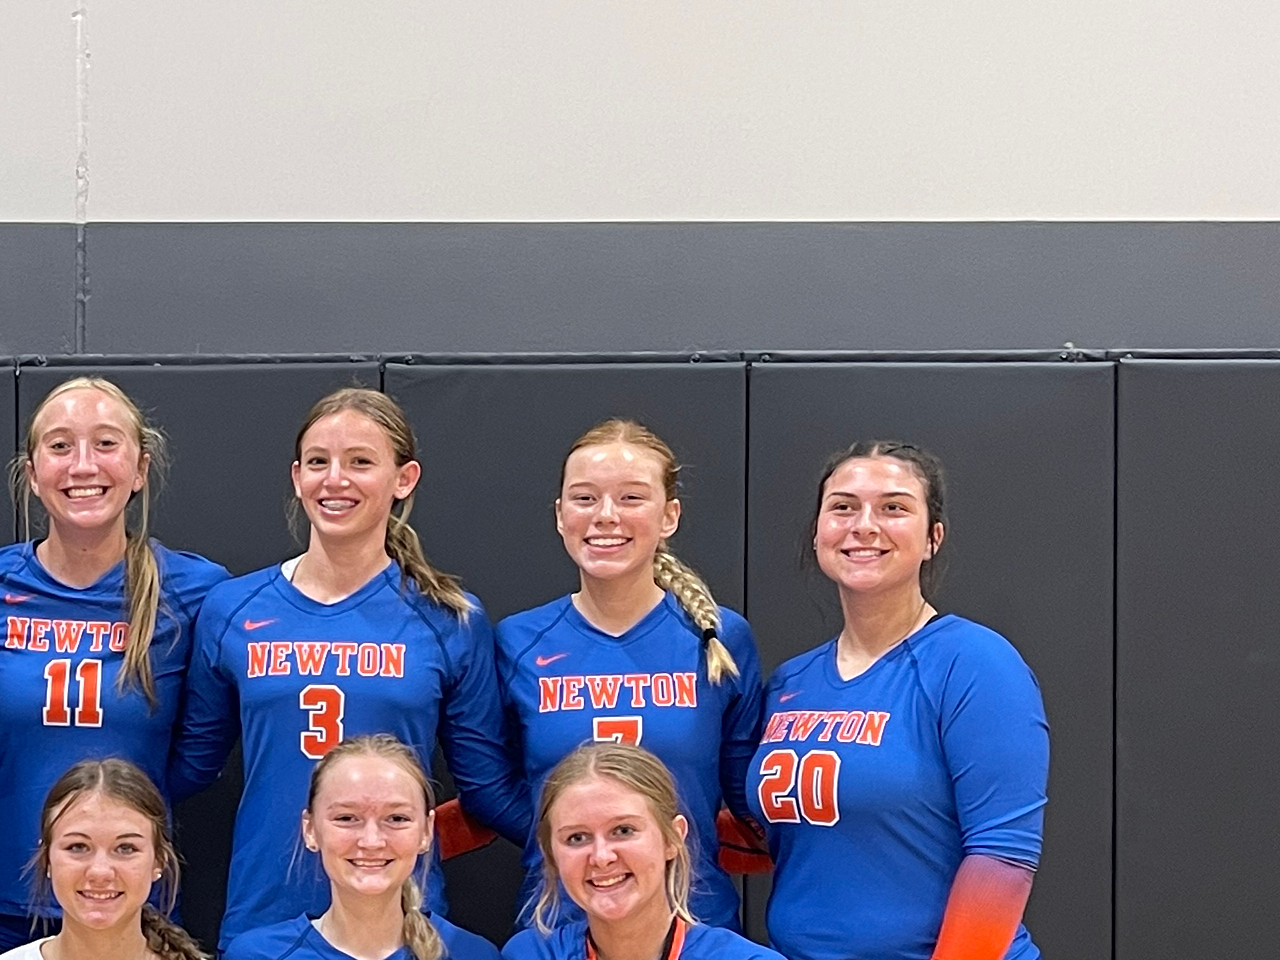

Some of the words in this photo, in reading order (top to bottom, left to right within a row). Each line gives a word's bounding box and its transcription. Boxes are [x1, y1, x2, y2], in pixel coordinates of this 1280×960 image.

[5, 616, 132, 653] NEWTO
[247, 641, 406, 679] NEWTON
[42, 658, 104, 728] 11
[538, 672, 698, 713] NEWTON
[299, 684, 346, 760] 3
[759, 711, 891, 746] NEWTON
[757, 749, 842, 827] 20
